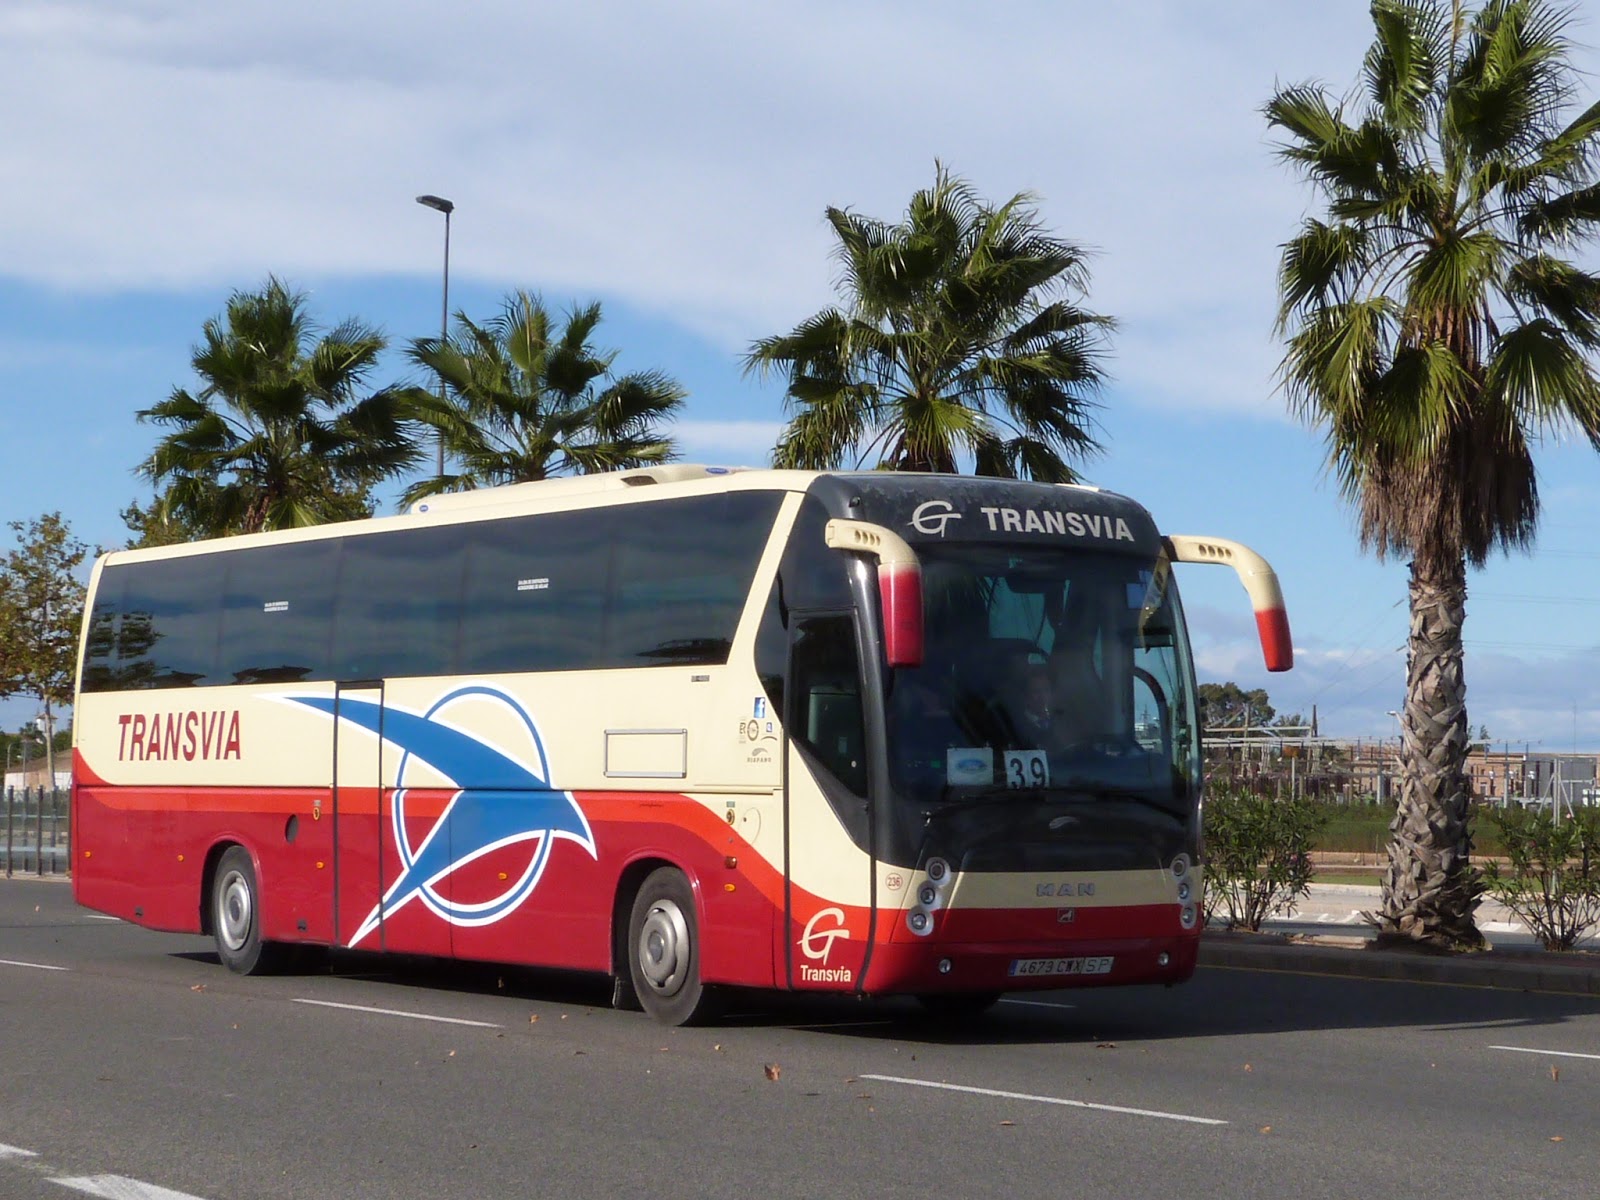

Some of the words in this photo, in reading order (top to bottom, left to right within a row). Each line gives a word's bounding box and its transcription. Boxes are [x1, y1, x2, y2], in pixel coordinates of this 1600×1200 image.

[980, 507, 1135, 542] TRANSVIA
[118, 710, 242, 762] TRANSVIA
[1010, 756, 1046, 790] 39
[1036, 883, 1095, 897] MAN
[800, 964, 852, 982] Transvia
